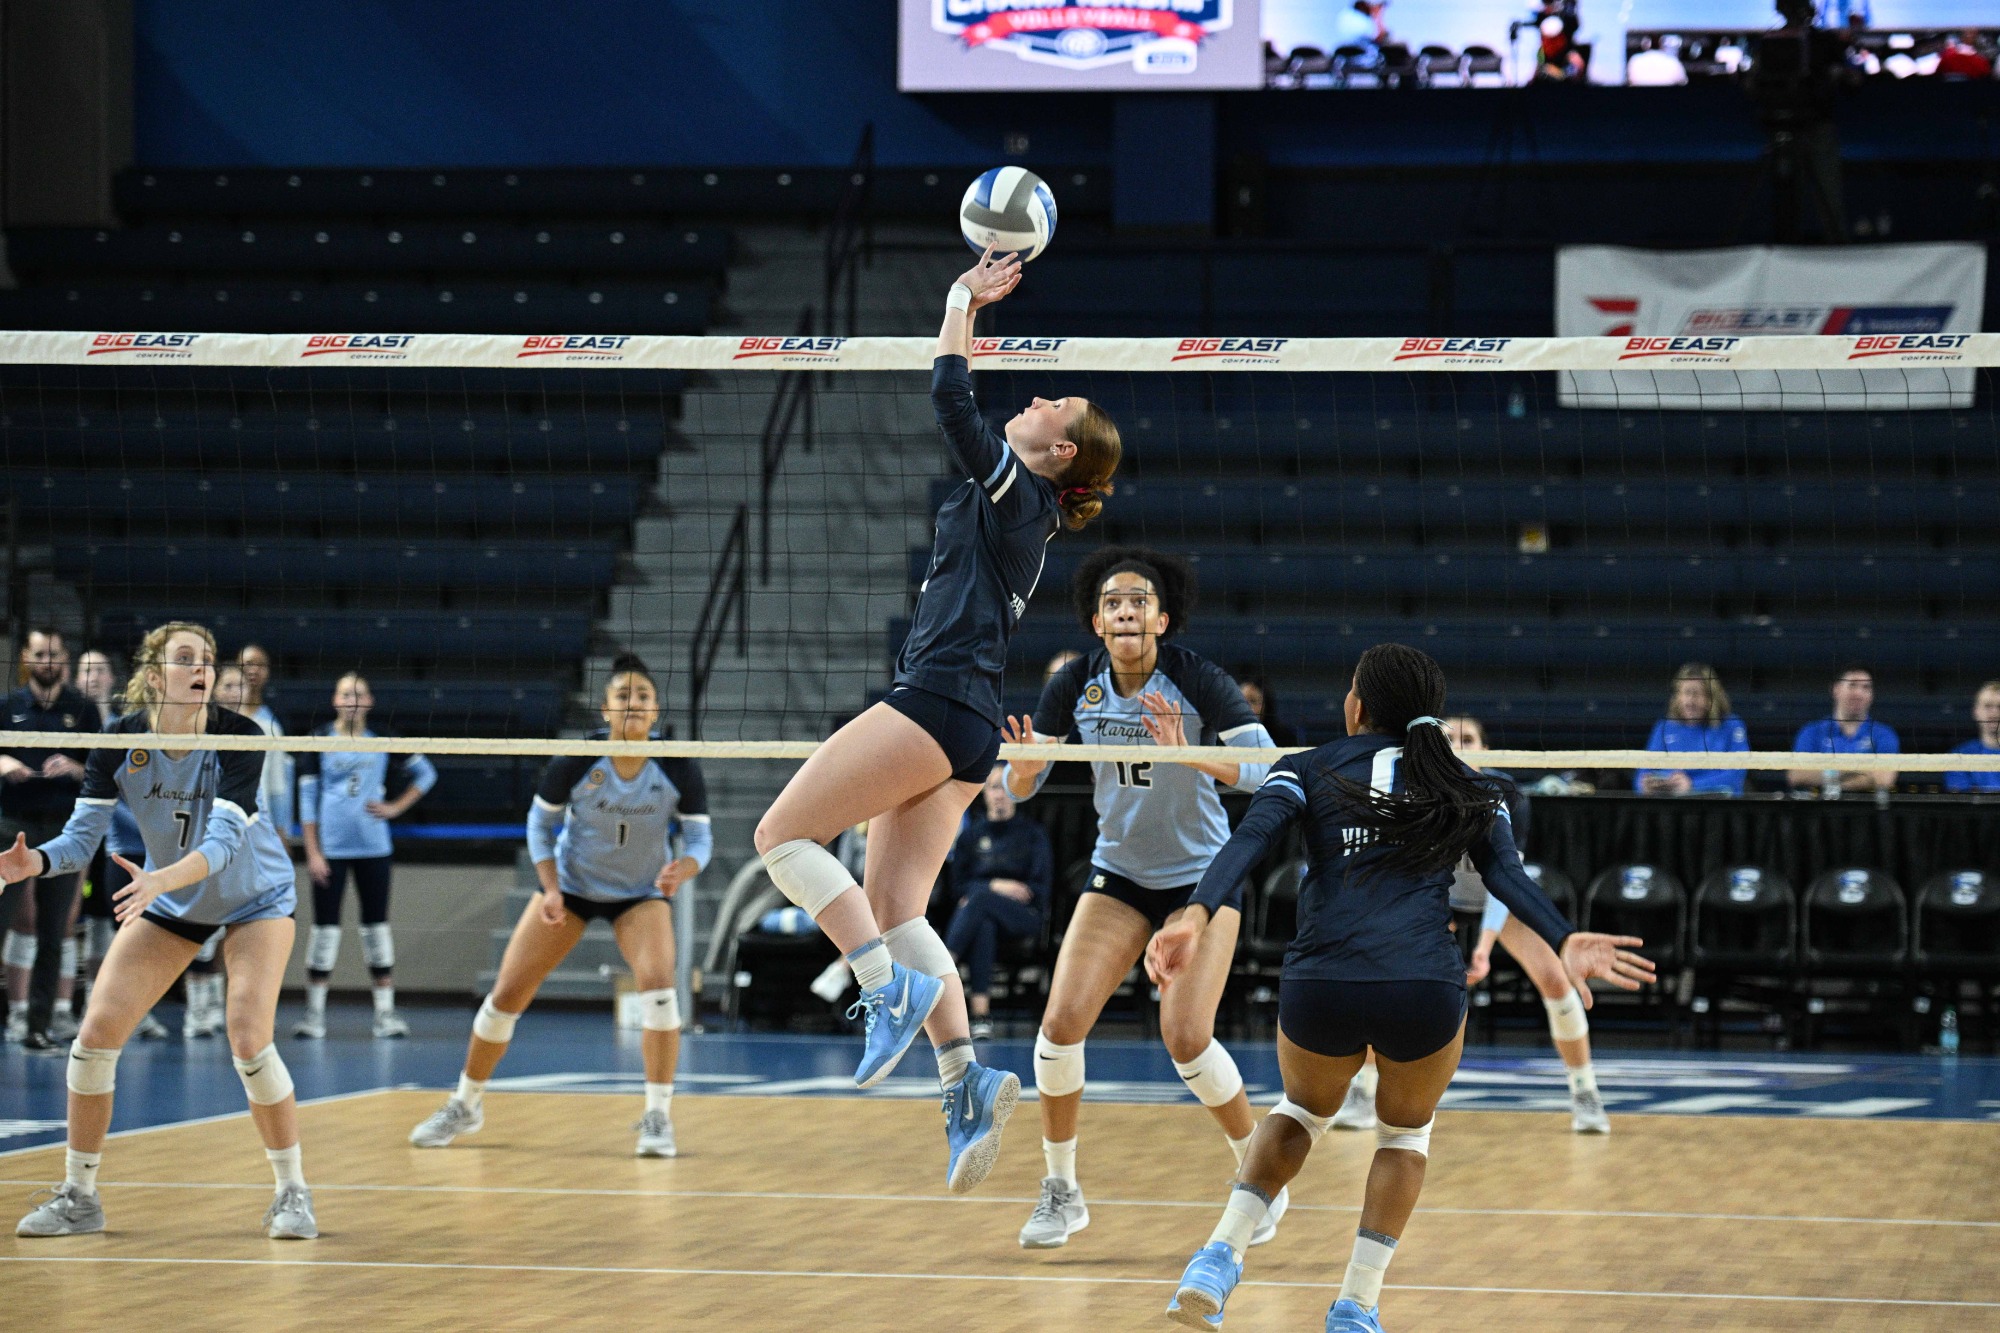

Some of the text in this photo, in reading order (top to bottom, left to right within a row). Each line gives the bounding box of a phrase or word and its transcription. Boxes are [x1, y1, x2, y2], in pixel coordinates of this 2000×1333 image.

[1091, 719, 1155, 743] Marque
[1115, 761, 1153, 789] 12
[173, 810, 191, 850] 7
[616, 820, 630, 850] 1
